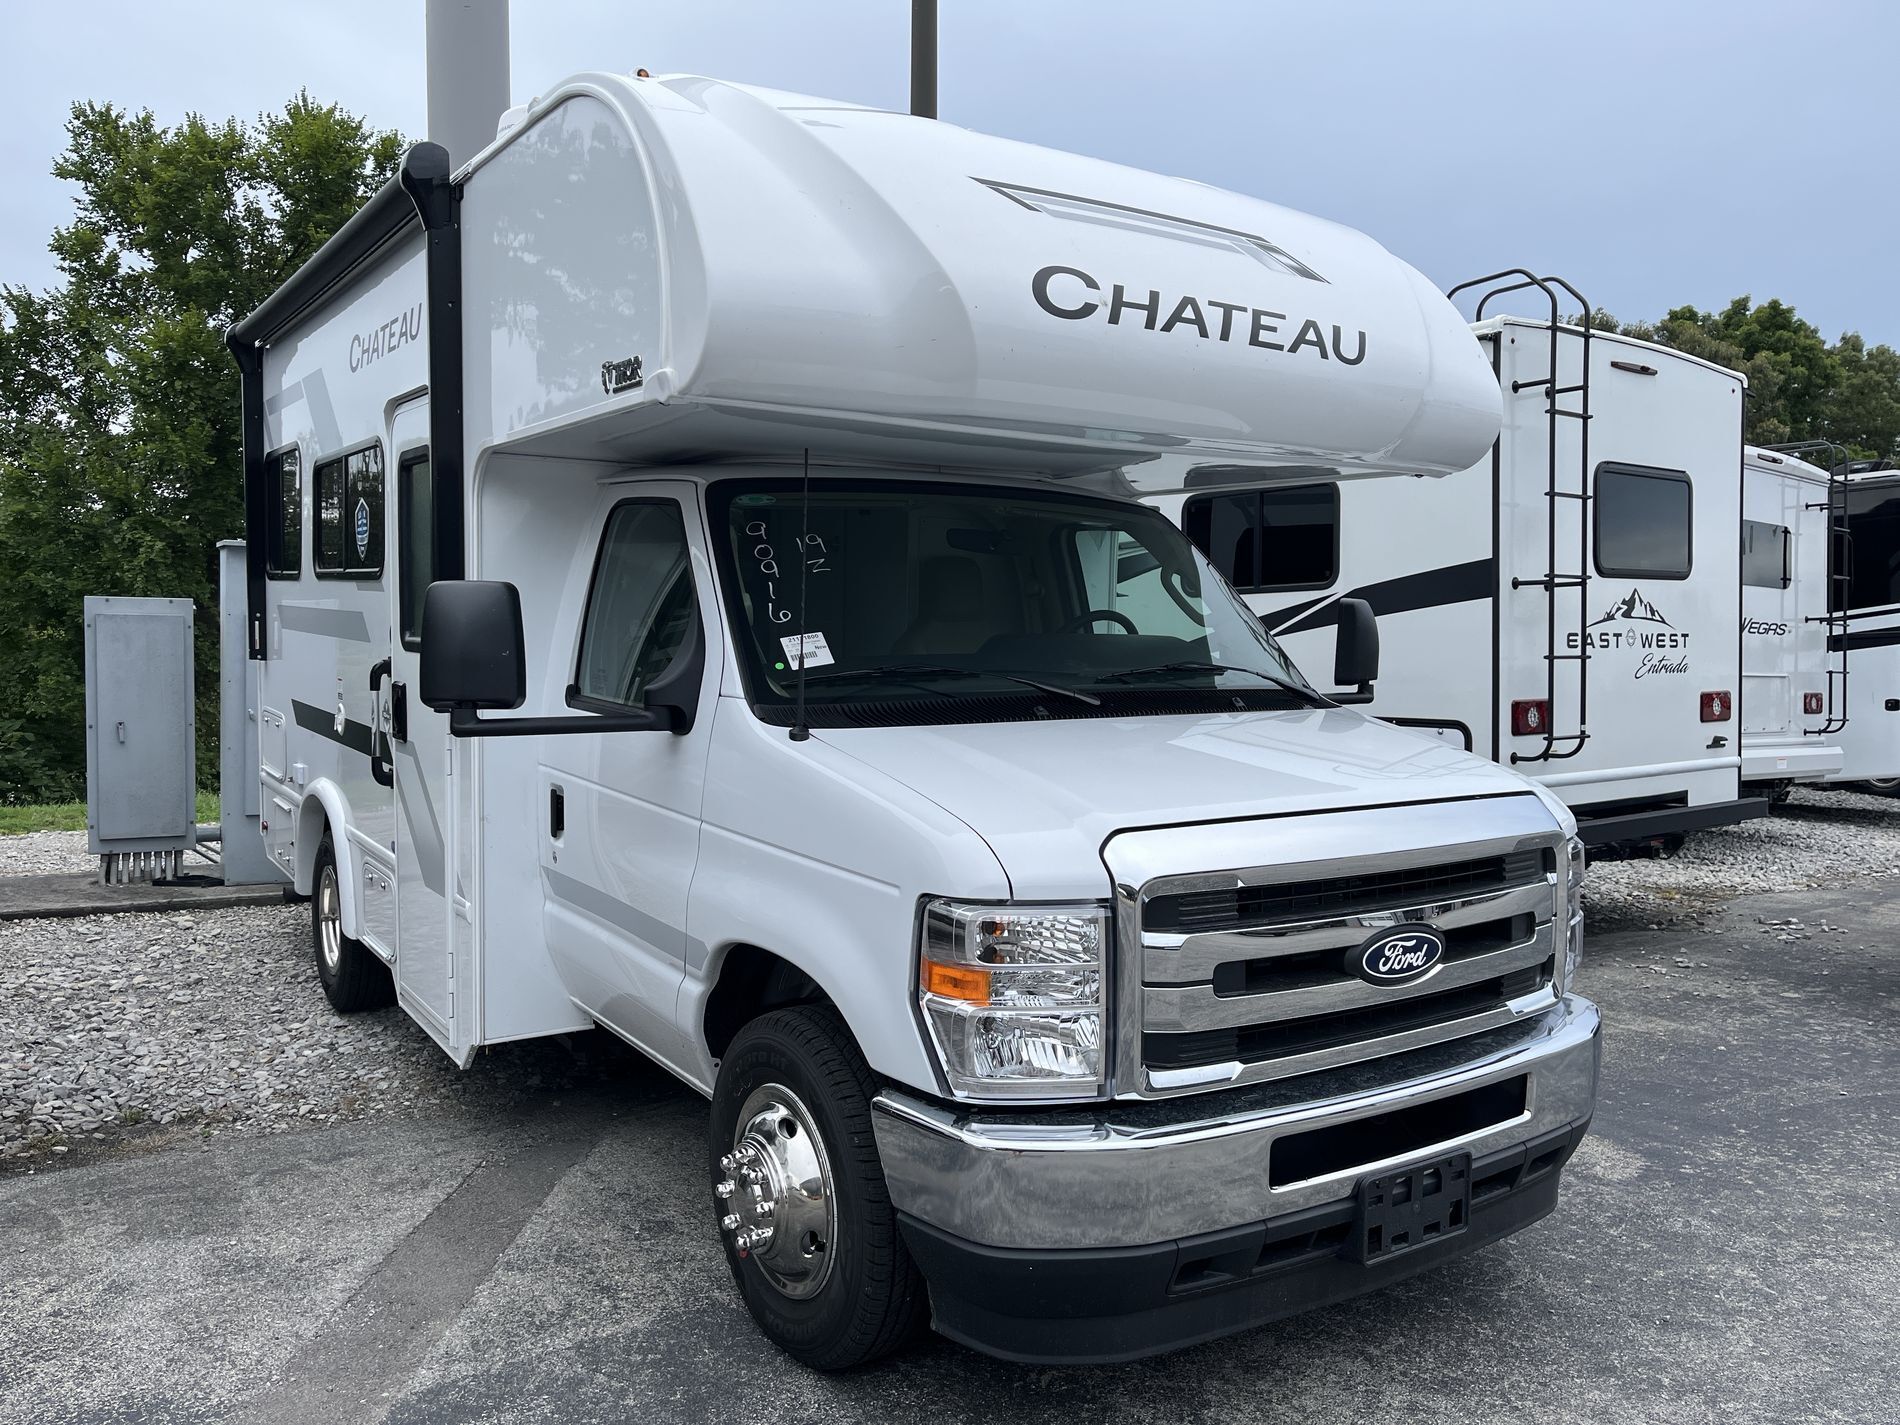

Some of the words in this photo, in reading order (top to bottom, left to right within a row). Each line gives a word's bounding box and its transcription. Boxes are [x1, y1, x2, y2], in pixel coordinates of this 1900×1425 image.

[1031, 265, 1367, 366] CHATEAU
[349, 302, 423, 373] CHATEAU
[787, 633, 820, 643] 2111800
[1566, 632, 1622, 648] EAST
[1640, 633, 1690, 648] WEST
[1741, 617, 1788, 636] VEGAS
[1634, 652, 1690, 680] Entrada
[1378, 939, 1429, 972] Ford
